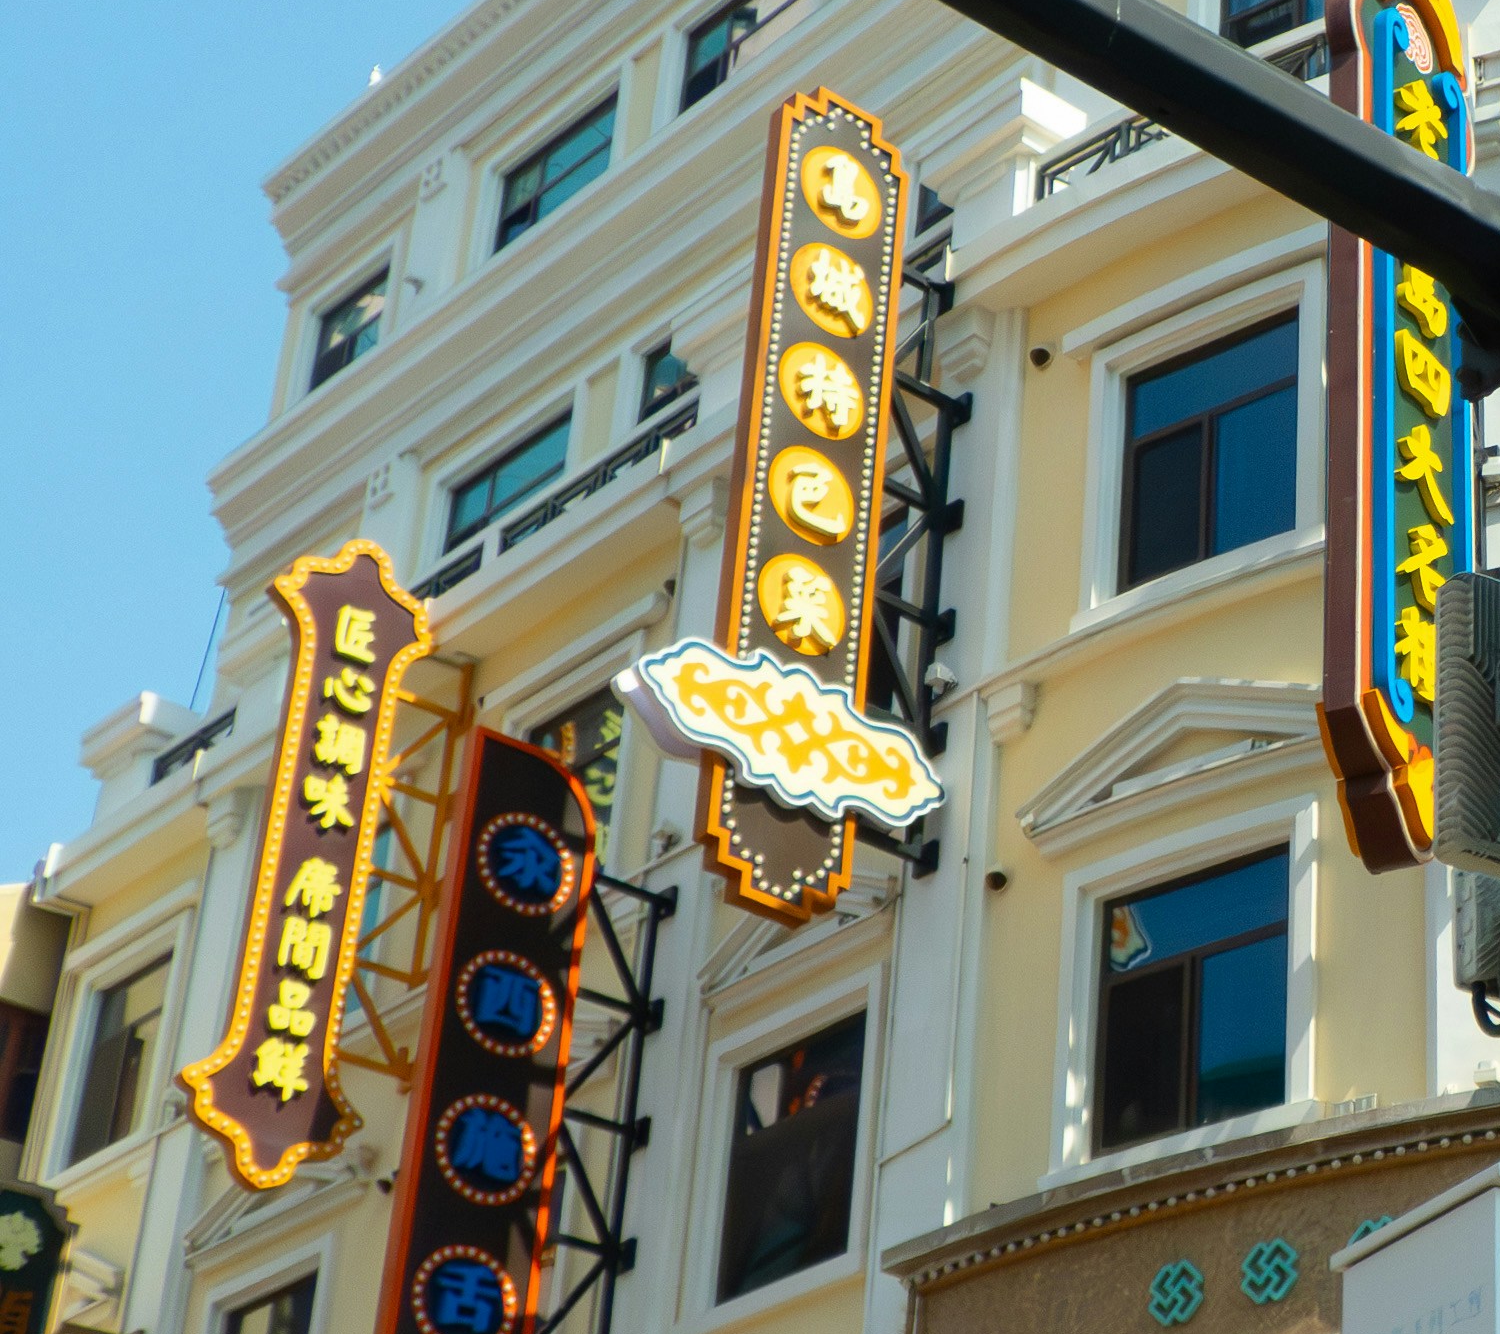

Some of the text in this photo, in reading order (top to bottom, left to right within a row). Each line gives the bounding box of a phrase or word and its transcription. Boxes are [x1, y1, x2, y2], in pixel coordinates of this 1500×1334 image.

[777, 154, 869, 648] 島城特色菜
[251, 604, 378, 1103] 匠心調味 席間品鮮
